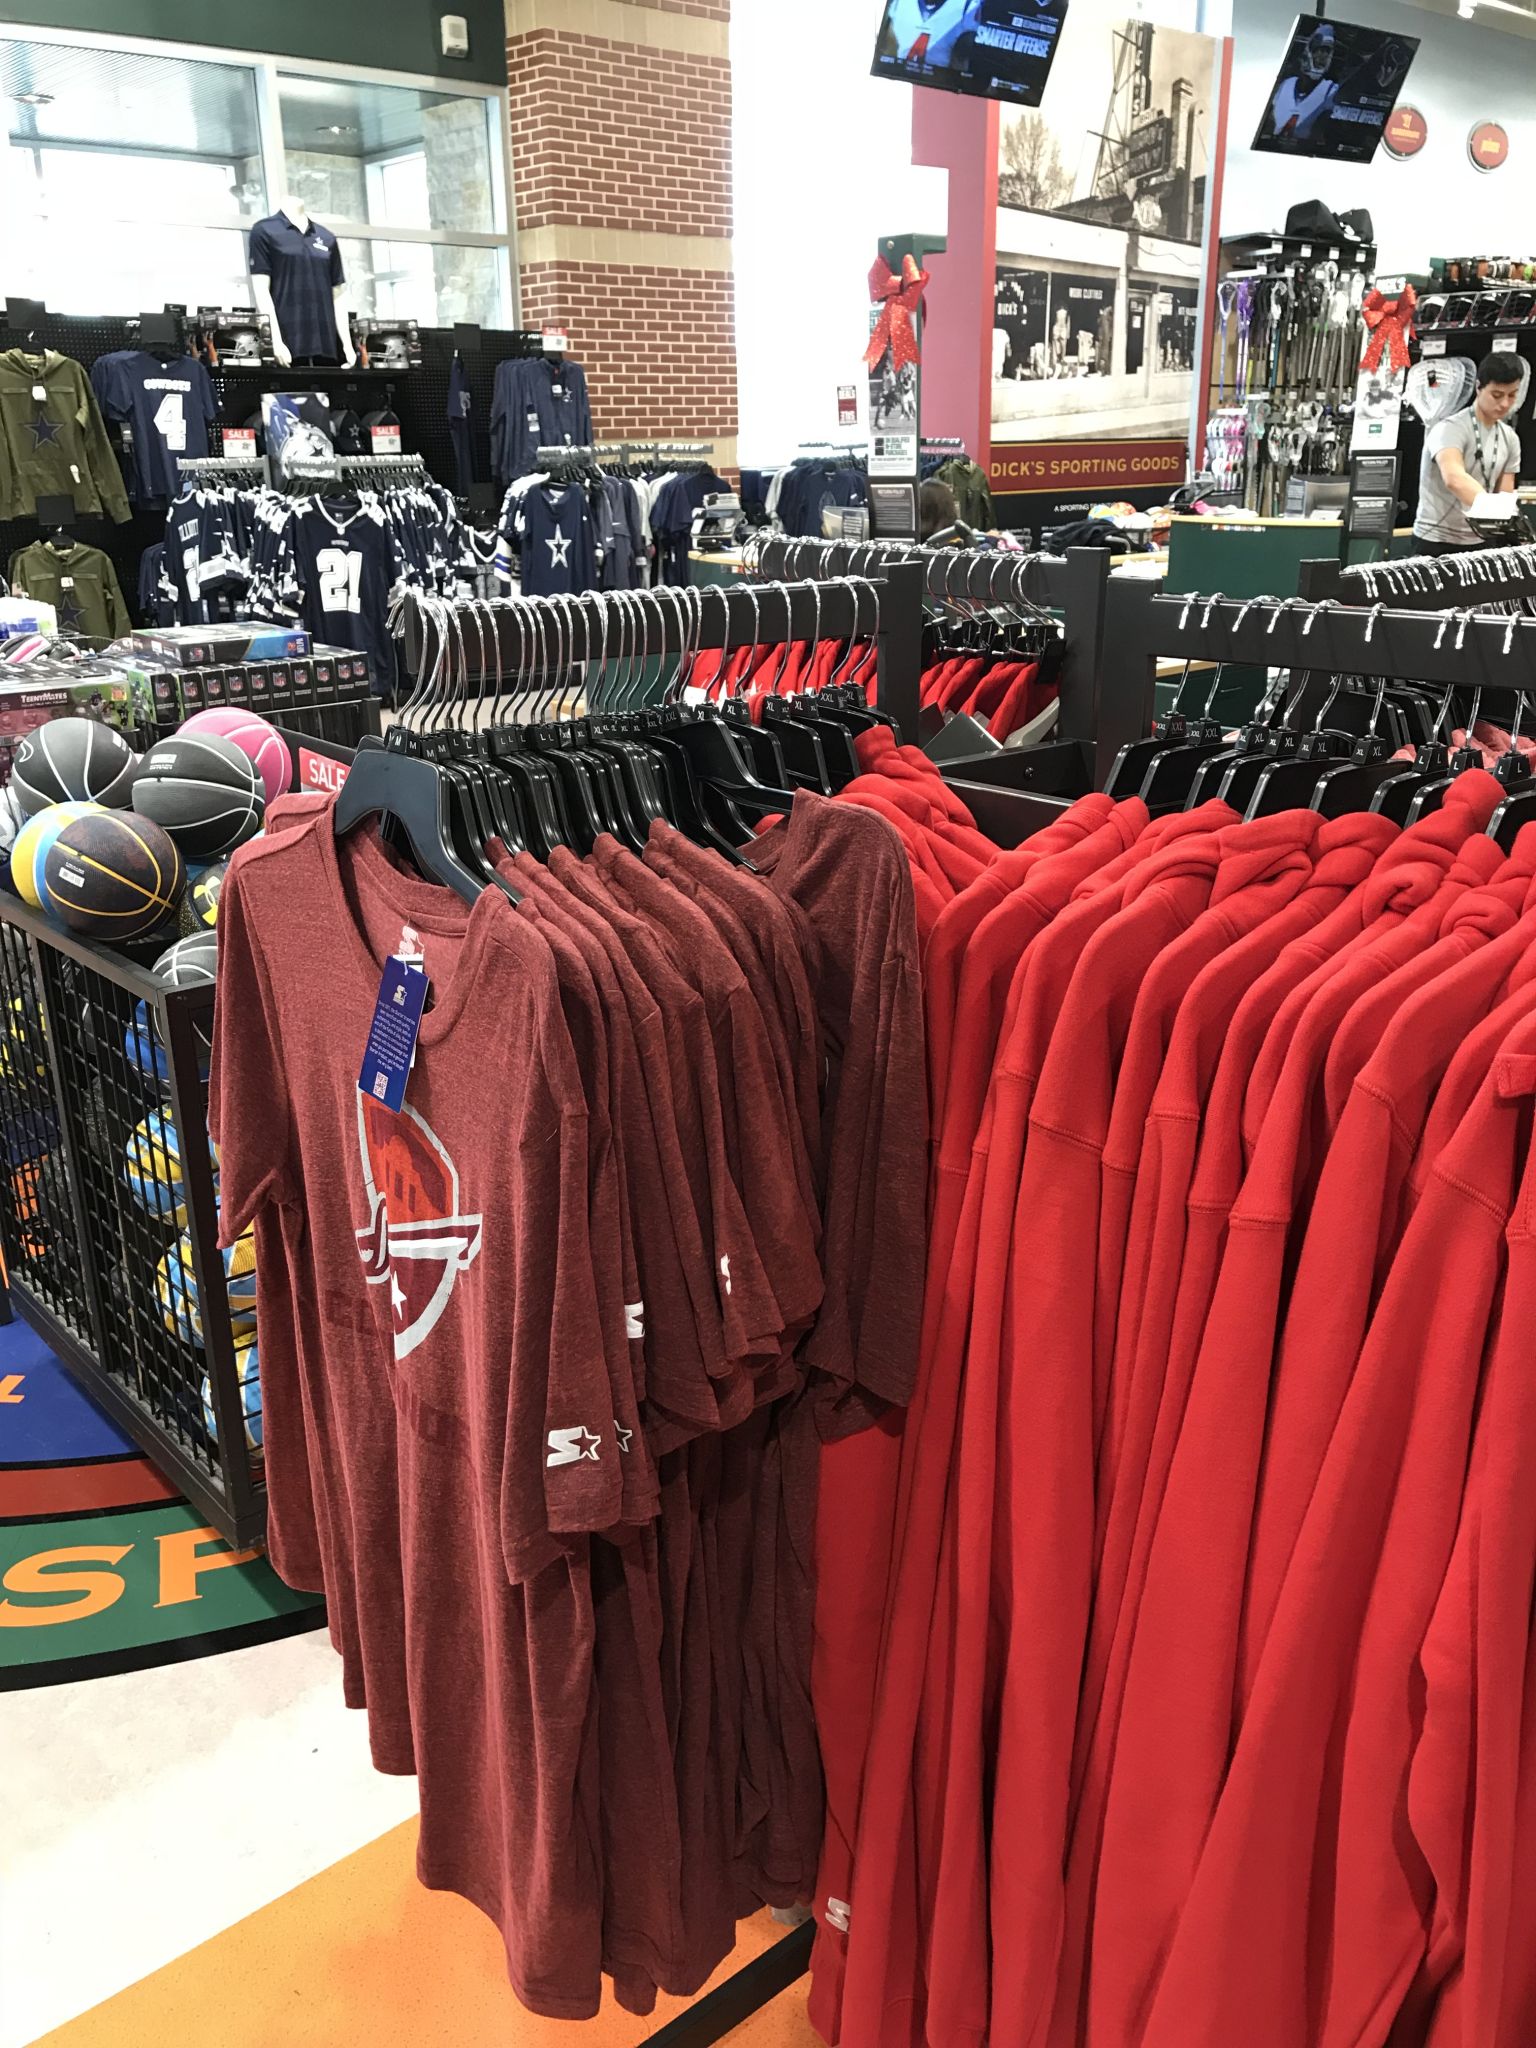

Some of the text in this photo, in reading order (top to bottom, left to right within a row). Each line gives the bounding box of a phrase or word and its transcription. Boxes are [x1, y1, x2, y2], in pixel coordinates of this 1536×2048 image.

[974, 25, 1051, 58] SMARTER OFFENSE
[152, 393, 187, 451] 4
[227, 429, 250, 440] SALE
[376, 426, 395, 436] SALE
[991, 456, 1180, 478] DICK'S SPORTING GOODS
[316, 548, 363, 614] 21
[820, 692, 834, 703] XXL
[727, 704, 736, 715] XL
[766, 701, 775, 711] XL
[795, 700, 803, 710] XL
[665, 712, 677, 722] XXL
[698, 710, 705, 720] XL
[593, 726, 603, 734] XL
[1172, 722, 1183, 732] XXL
[1205, 728, 1218, 738] XXL
[1255, 733, 1265, 744] XL
[1285, 737, 1295, 747] XL
[409, 741, 417, 750] M
[438, 744, 447, 753] M
[466, 741, 472, 749] L
[1318, 742, 1327, 753] XL
[426, 749, 435, 758] M
[482, 747, 488, 755] L
[1372, 746, 1382, 757] XL
[1419, 756, 1424, 765] L
[1453, 761, 1459, 770] L
[1498, 766, 1504, 775] L
[1518, 762, 1522, 773] L
[309, 758, 346, 791] SALE
